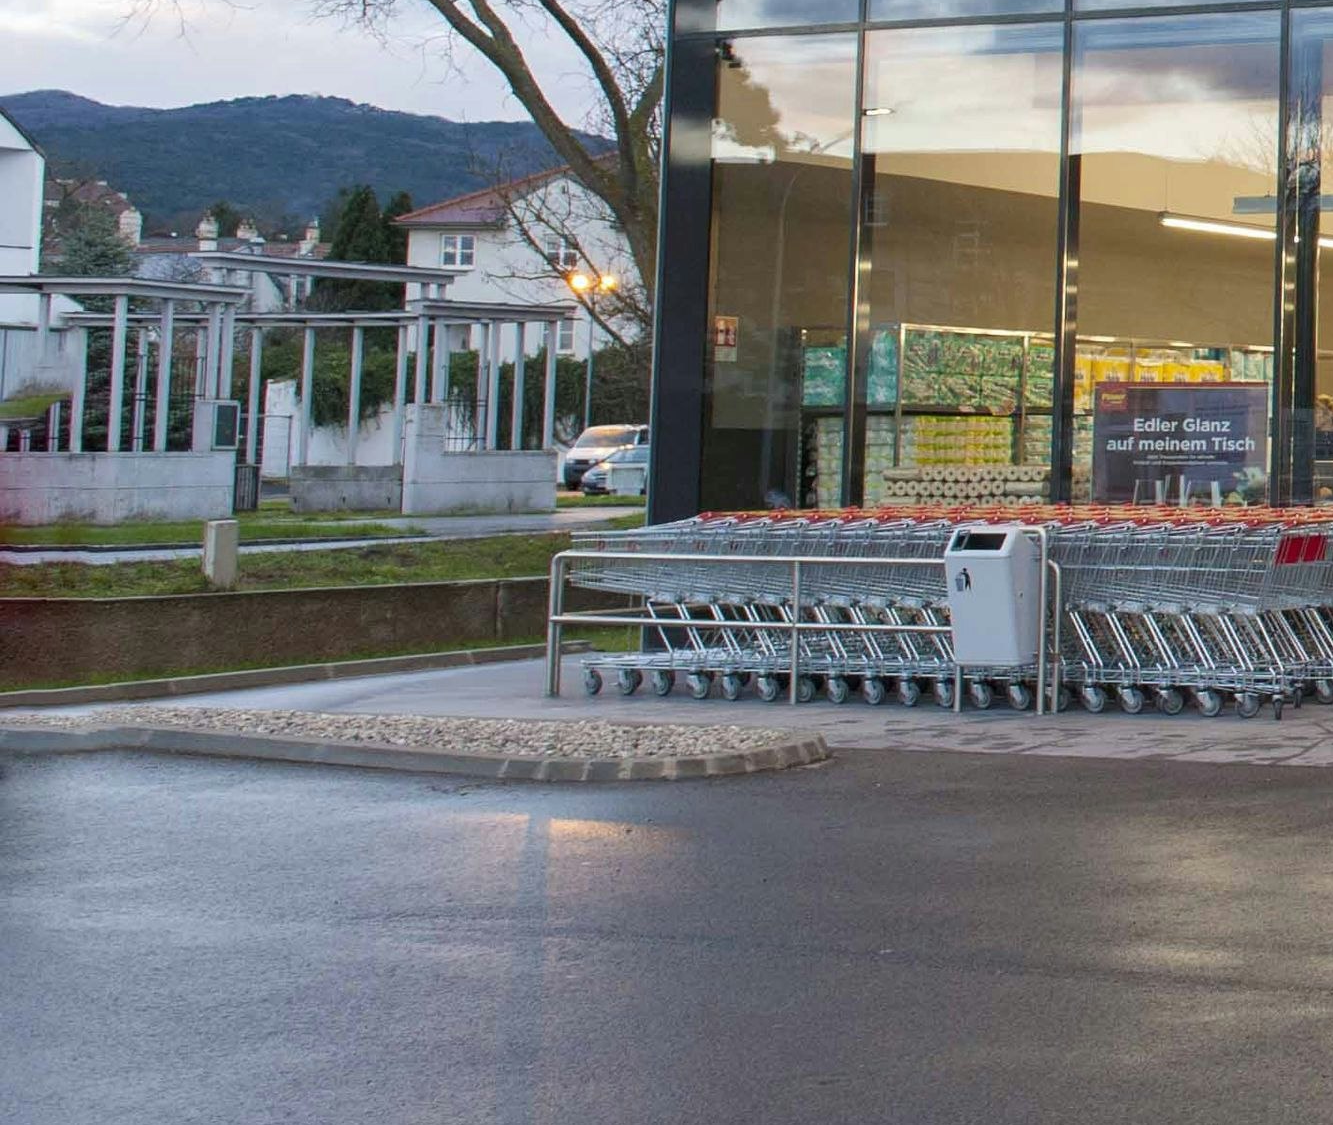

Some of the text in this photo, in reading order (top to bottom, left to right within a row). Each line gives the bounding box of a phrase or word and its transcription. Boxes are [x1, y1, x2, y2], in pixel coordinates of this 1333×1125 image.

[1133, 418, 1231, 432] Edler Glanz
[1106, 436, 1256, 451] auf meinem Tisch
